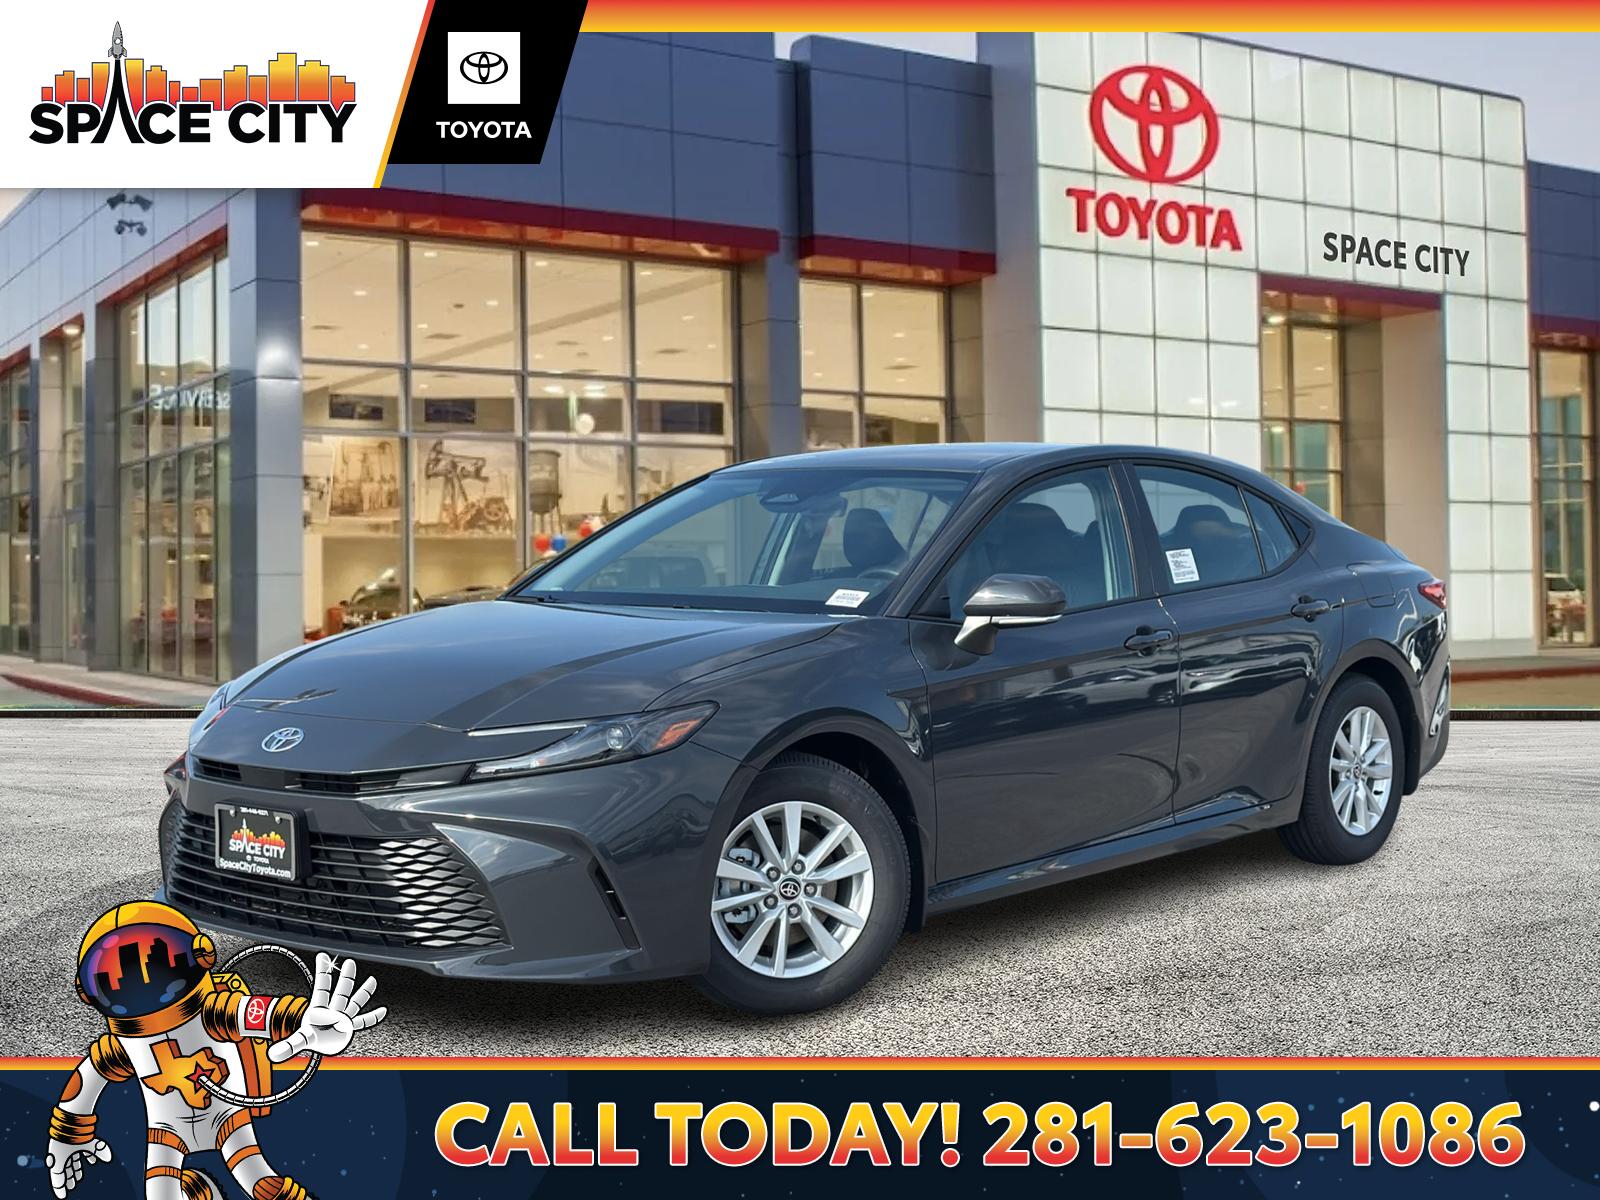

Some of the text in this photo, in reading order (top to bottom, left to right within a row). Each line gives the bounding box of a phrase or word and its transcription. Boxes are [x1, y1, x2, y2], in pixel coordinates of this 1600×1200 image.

[1066, 187, 1242, 251] TOYOTA
[1323, 231, 1470, 277] SPACE CITY
[229, 836, 286, 859] SPACE CITY
[219, 858, 291, 878] SpaceCityToyota.com
